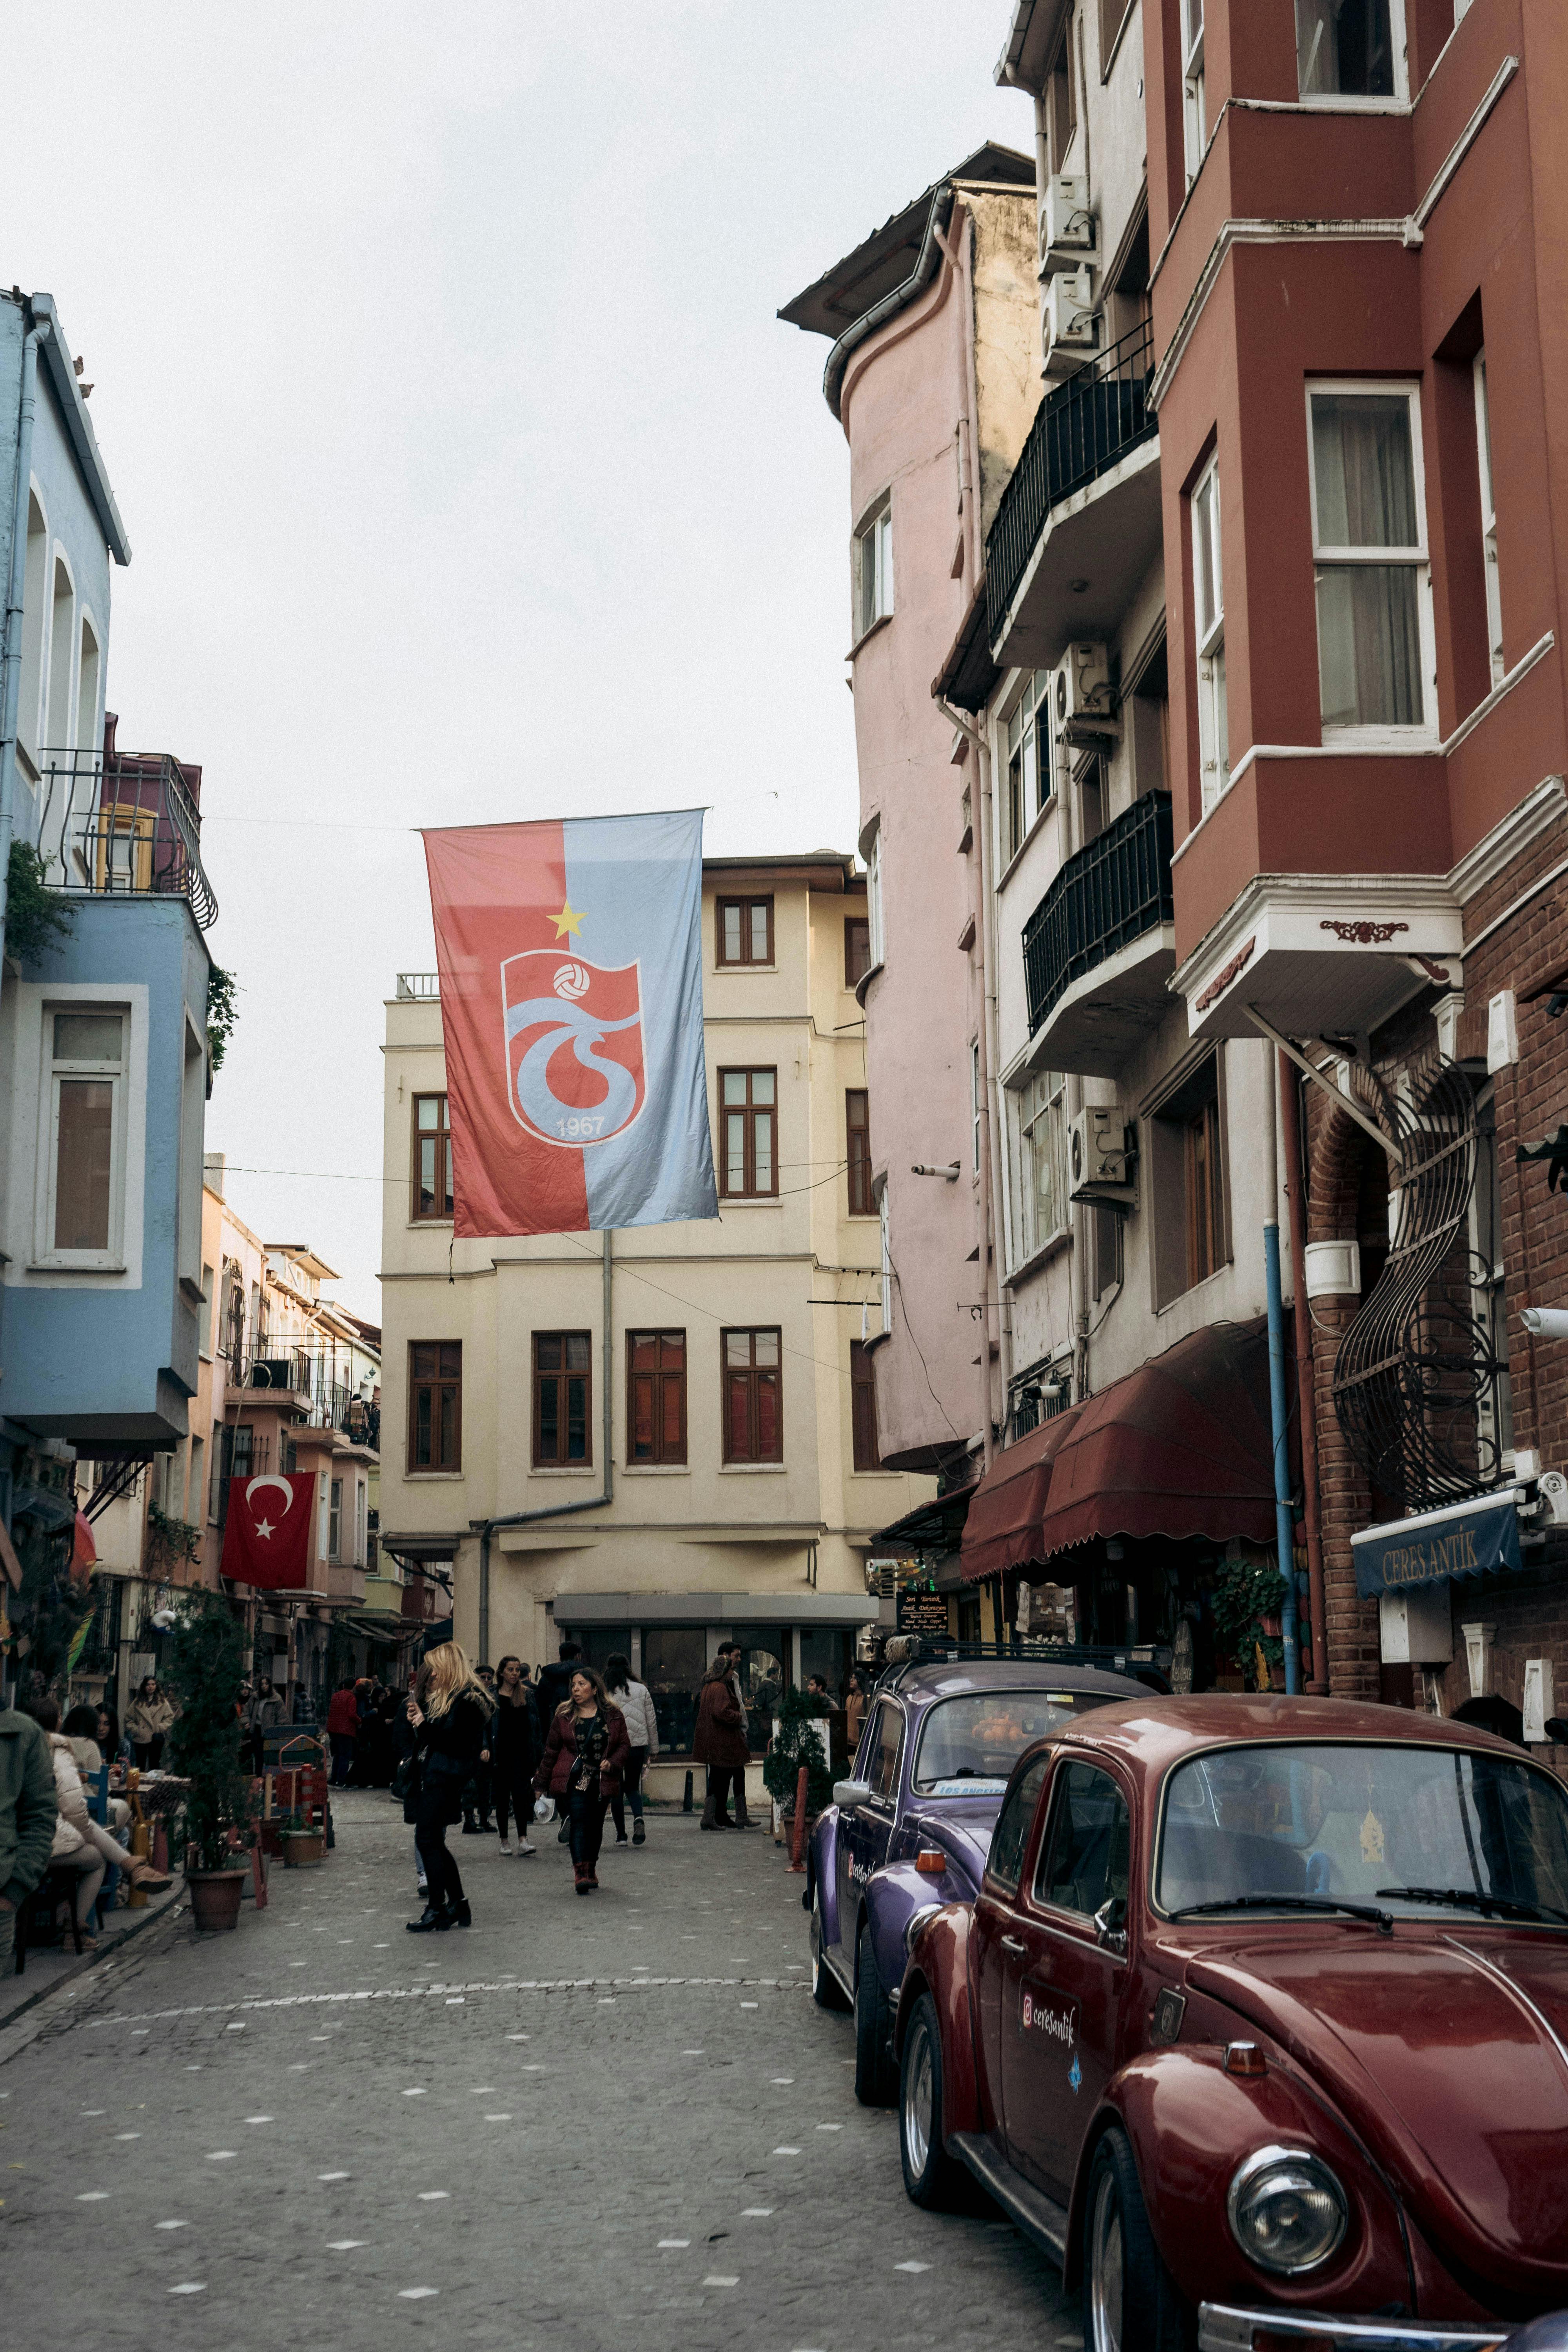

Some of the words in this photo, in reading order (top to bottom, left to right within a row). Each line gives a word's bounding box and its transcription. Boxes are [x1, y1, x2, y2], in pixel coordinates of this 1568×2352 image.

[556, 1116, 605, 1136] 1967
[1383, 1543, 1426, 1585] CERES
[1429, 1524, 1478, 1576] ANTİK
